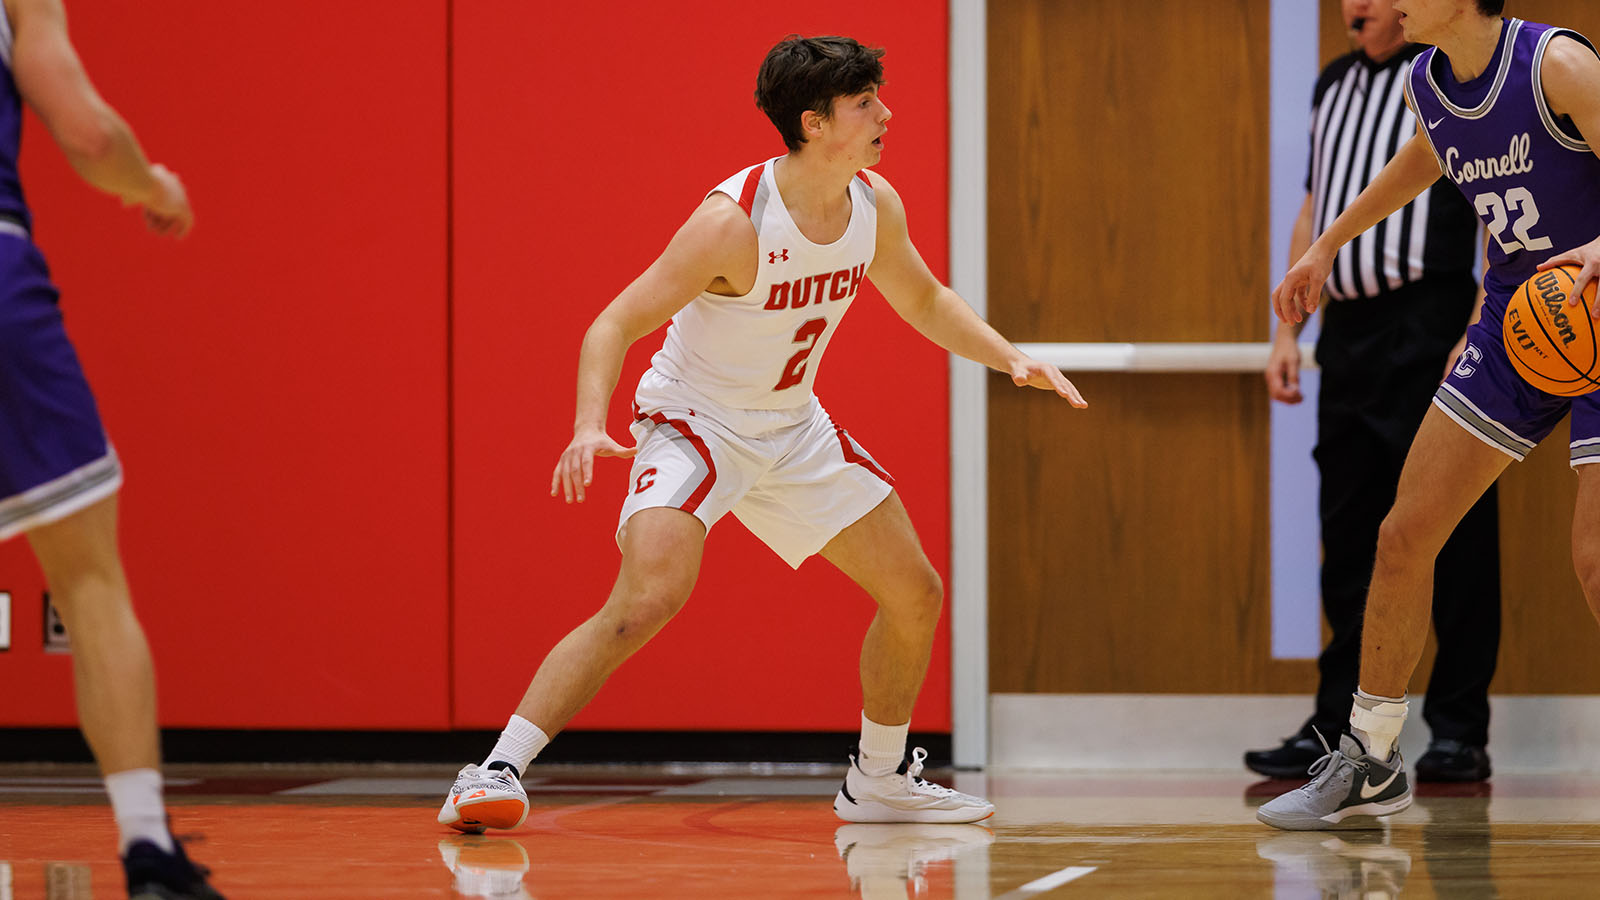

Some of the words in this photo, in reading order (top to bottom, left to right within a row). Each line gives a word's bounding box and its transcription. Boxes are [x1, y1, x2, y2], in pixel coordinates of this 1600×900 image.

[1446, 132, 1533, 184] Cornell
[1474, 186, 1553, 254] 22
[763, 262, 866, 310] DUTCH
[1534, 271, 1577, 349] Wilson
[772, 316, 828, 392] 2
[1508, 308, 1536, 351] EVO
[1453, 343, 1482, 378] C
[634, 467, 657, 495] C
